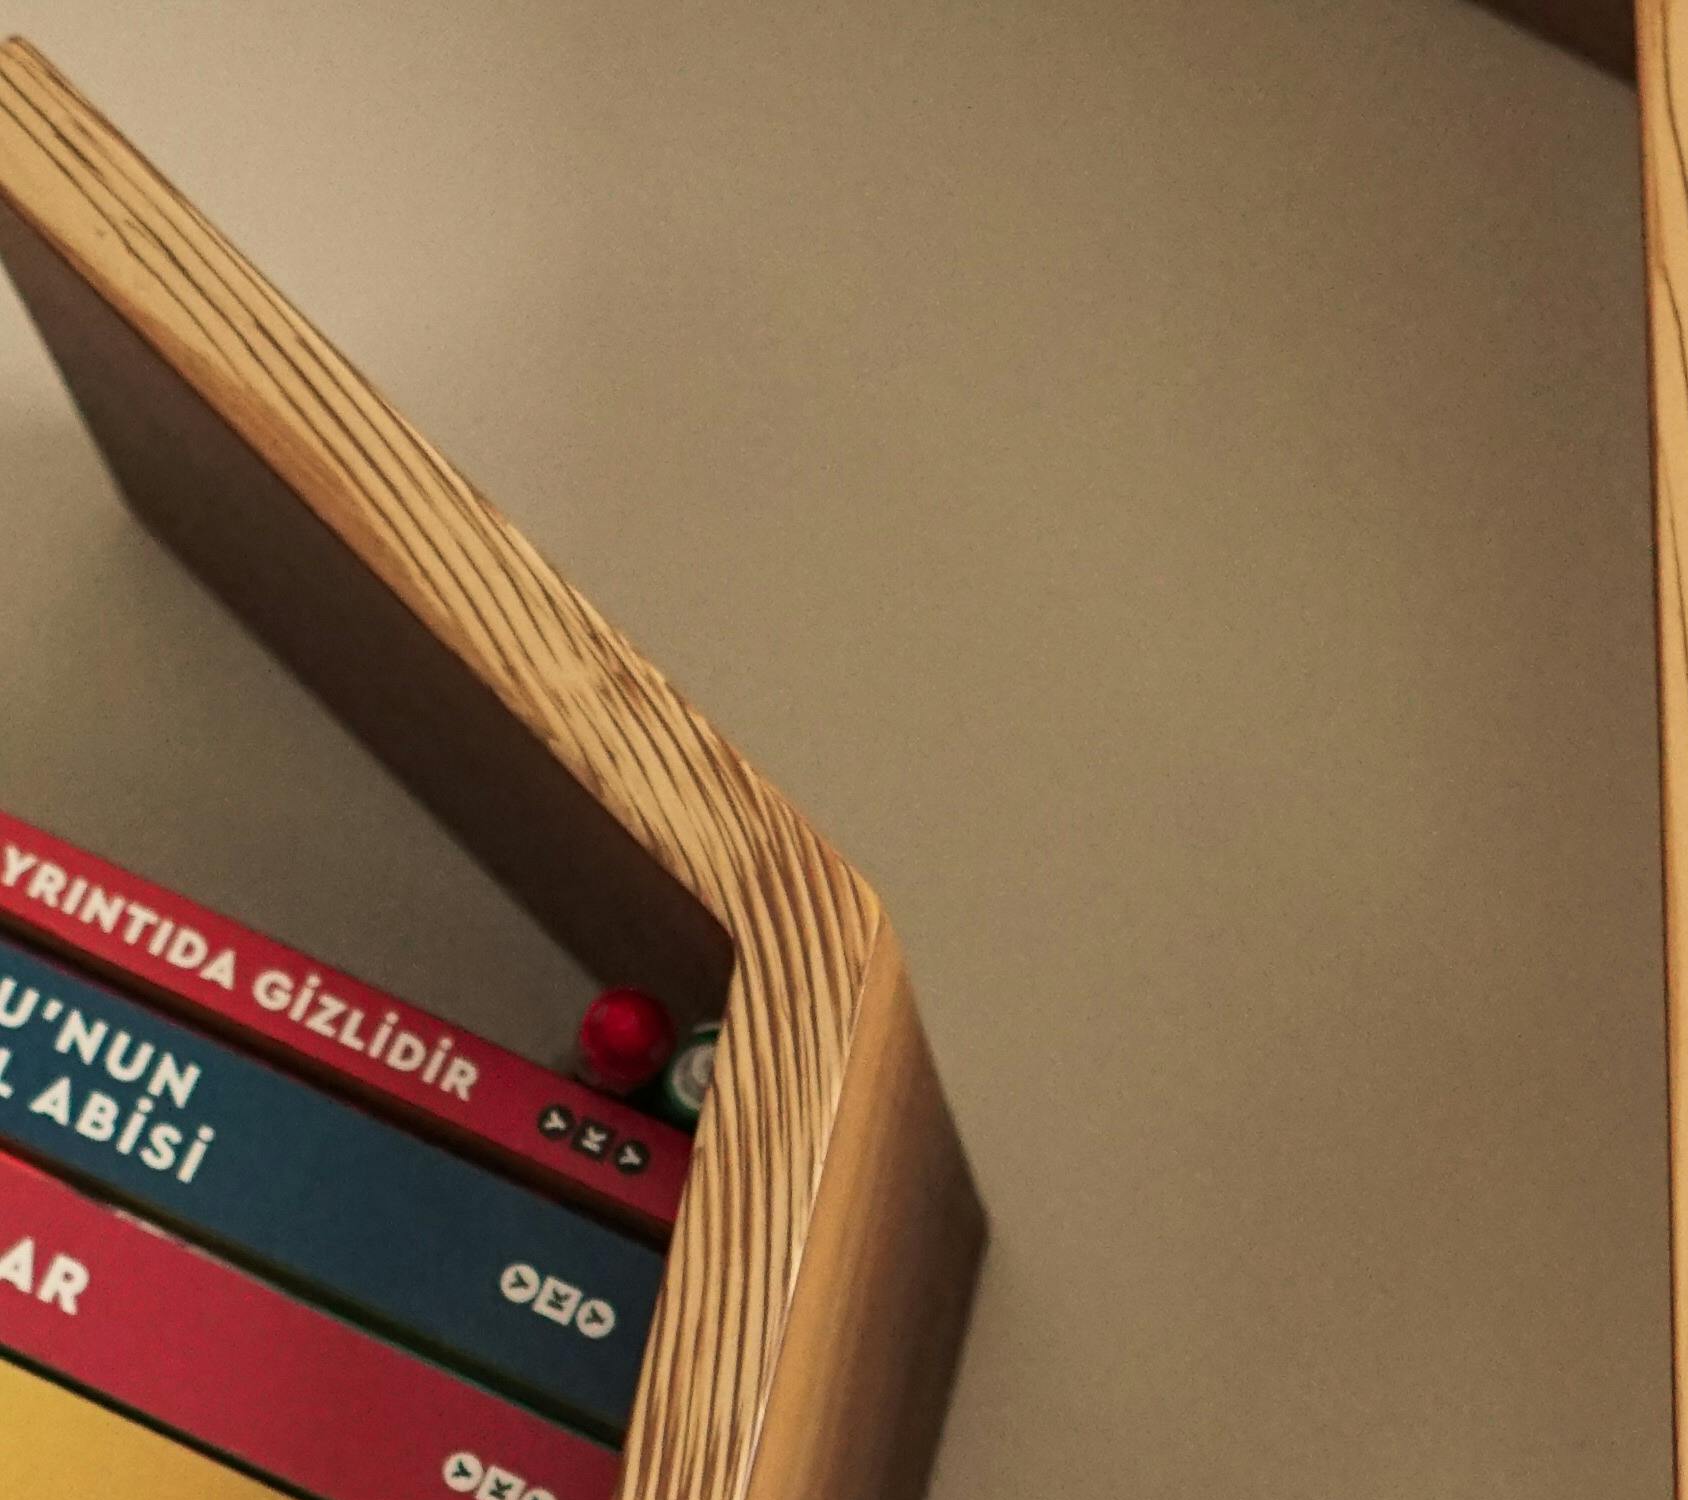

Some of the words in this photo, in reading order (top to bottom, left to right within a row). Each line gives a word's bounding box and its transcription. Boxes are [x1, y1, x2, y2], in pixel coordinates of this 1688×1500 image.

[1, 844, 237, 992] YRINTIDA
[251, 969, 482, 1102] GİZLİDİR
[28, 1075, 216, 1184] ABİSİ
[538, 1104, 651, 1175] YKY
[0, 1233, 91, 1318] AR
[500, 1264, 617, 1339] YKY
